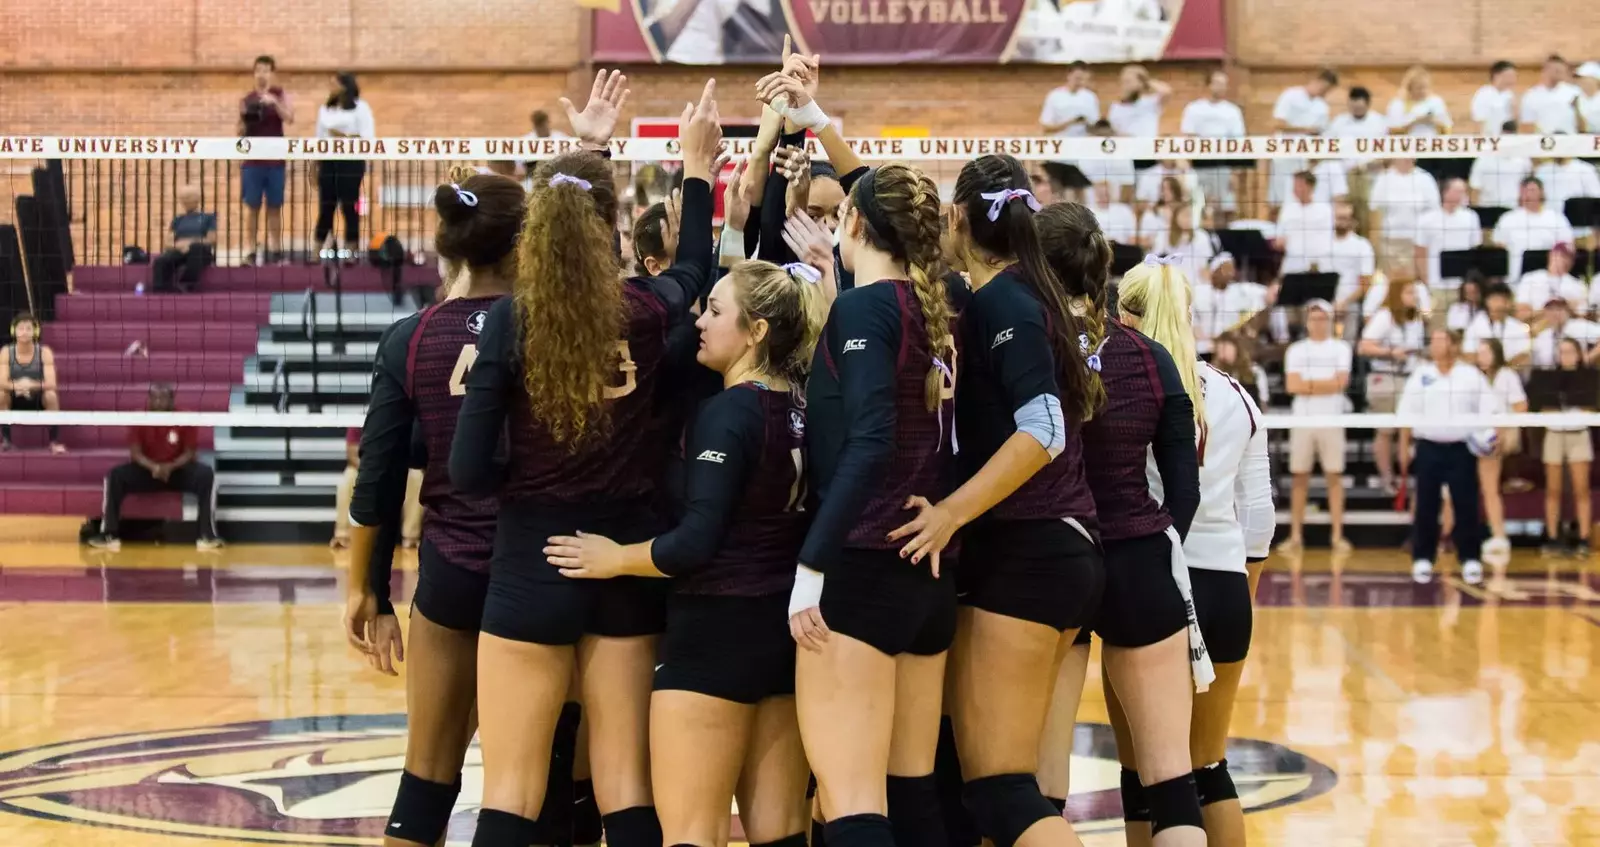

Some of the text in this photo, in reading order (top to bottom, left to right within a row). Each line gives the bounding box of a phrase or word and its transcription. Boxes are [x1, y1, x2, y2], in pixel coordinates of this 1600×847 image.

[808, 0, 1008, 24] VOLLEYBALL
[58, 138, 199, 154] UNIVERSITY
[287, 139, 387, 154] FLORIDA
[397, 139, 471, 154] STATE
[847, 139, 1064, 154] TATE UNIVERSITY
[1154, 137, 1501, 154] FLORIDA STATE UNIVERSITY
[991, 327, 1014, 349] ACC
[842, 339, 868, 354] ACC
[696, 449, 727, 464] ACC
